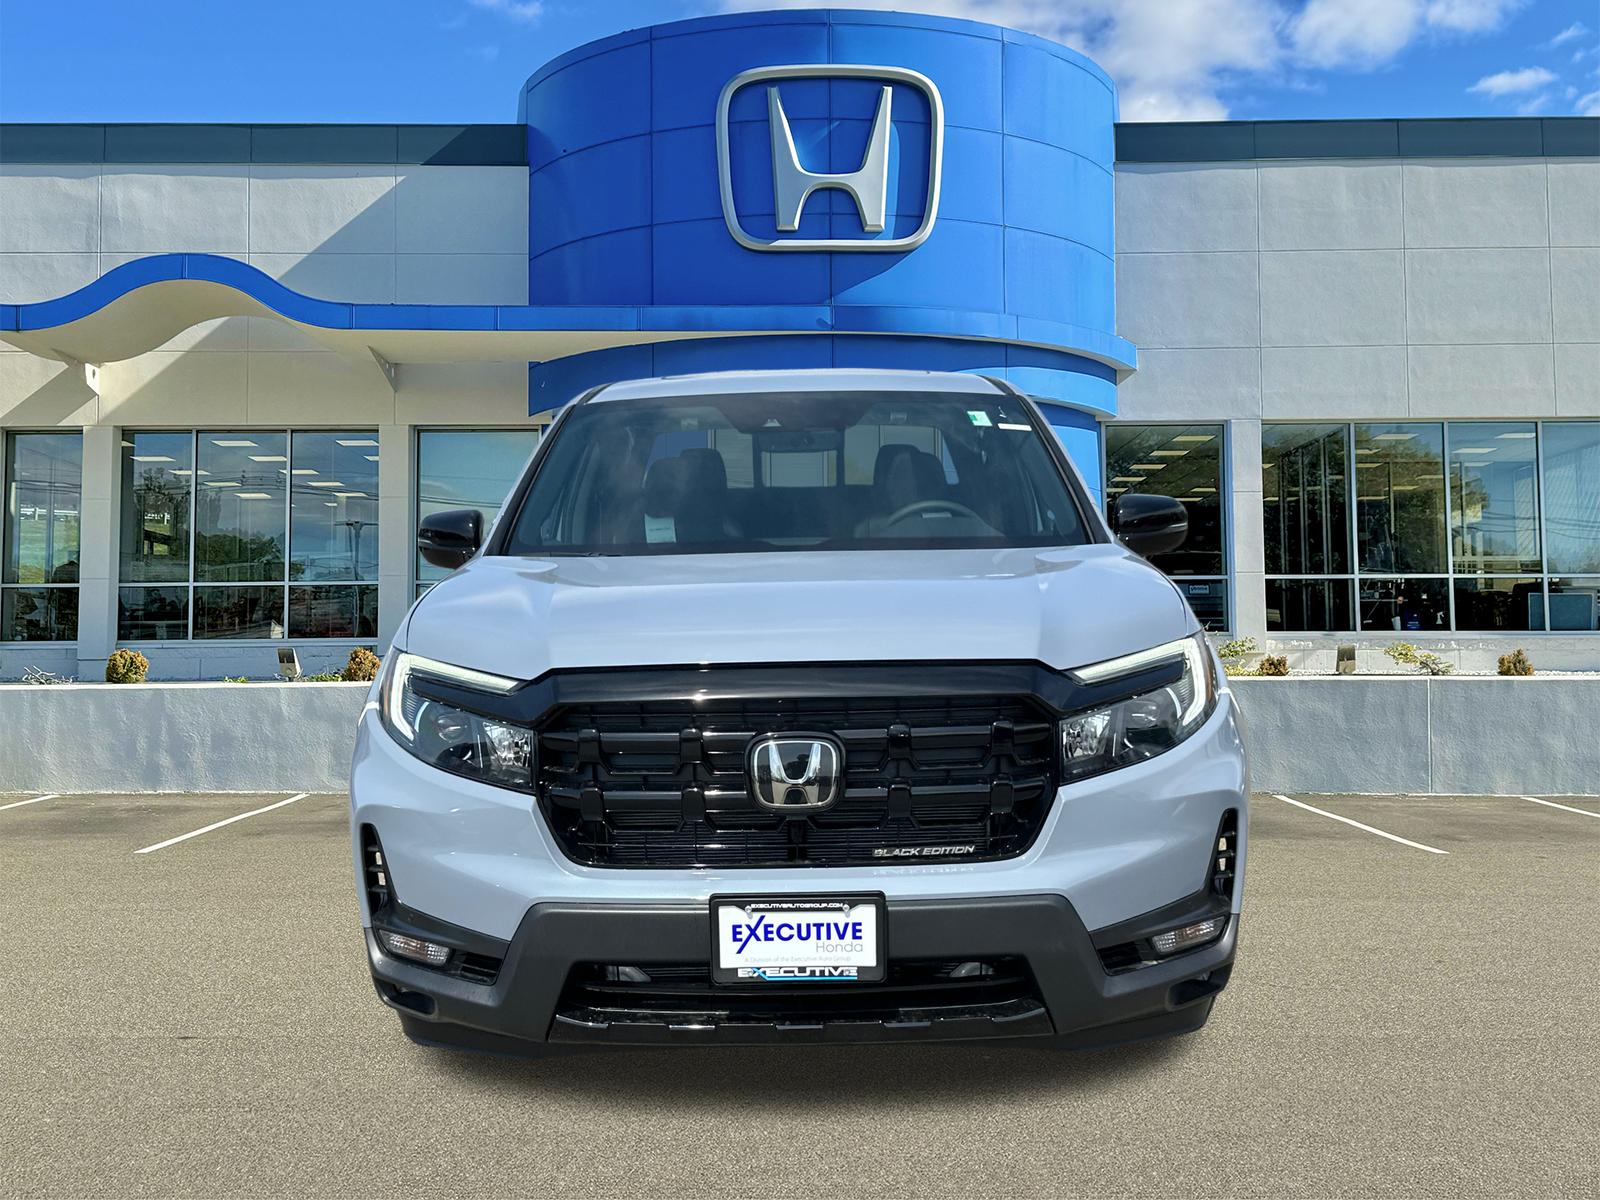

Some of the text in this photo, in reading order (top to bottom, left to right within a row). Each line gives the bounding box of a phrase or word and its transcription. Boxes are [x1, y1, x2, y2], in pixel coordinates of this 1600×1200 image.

[873, 845, 975, 857] BLACK EDITION
[731, 914, 863, 955] EXECUTIVE
[815, 941, 863, 953] Honda
[737, 966, 858, 980] EXECUTIVE
